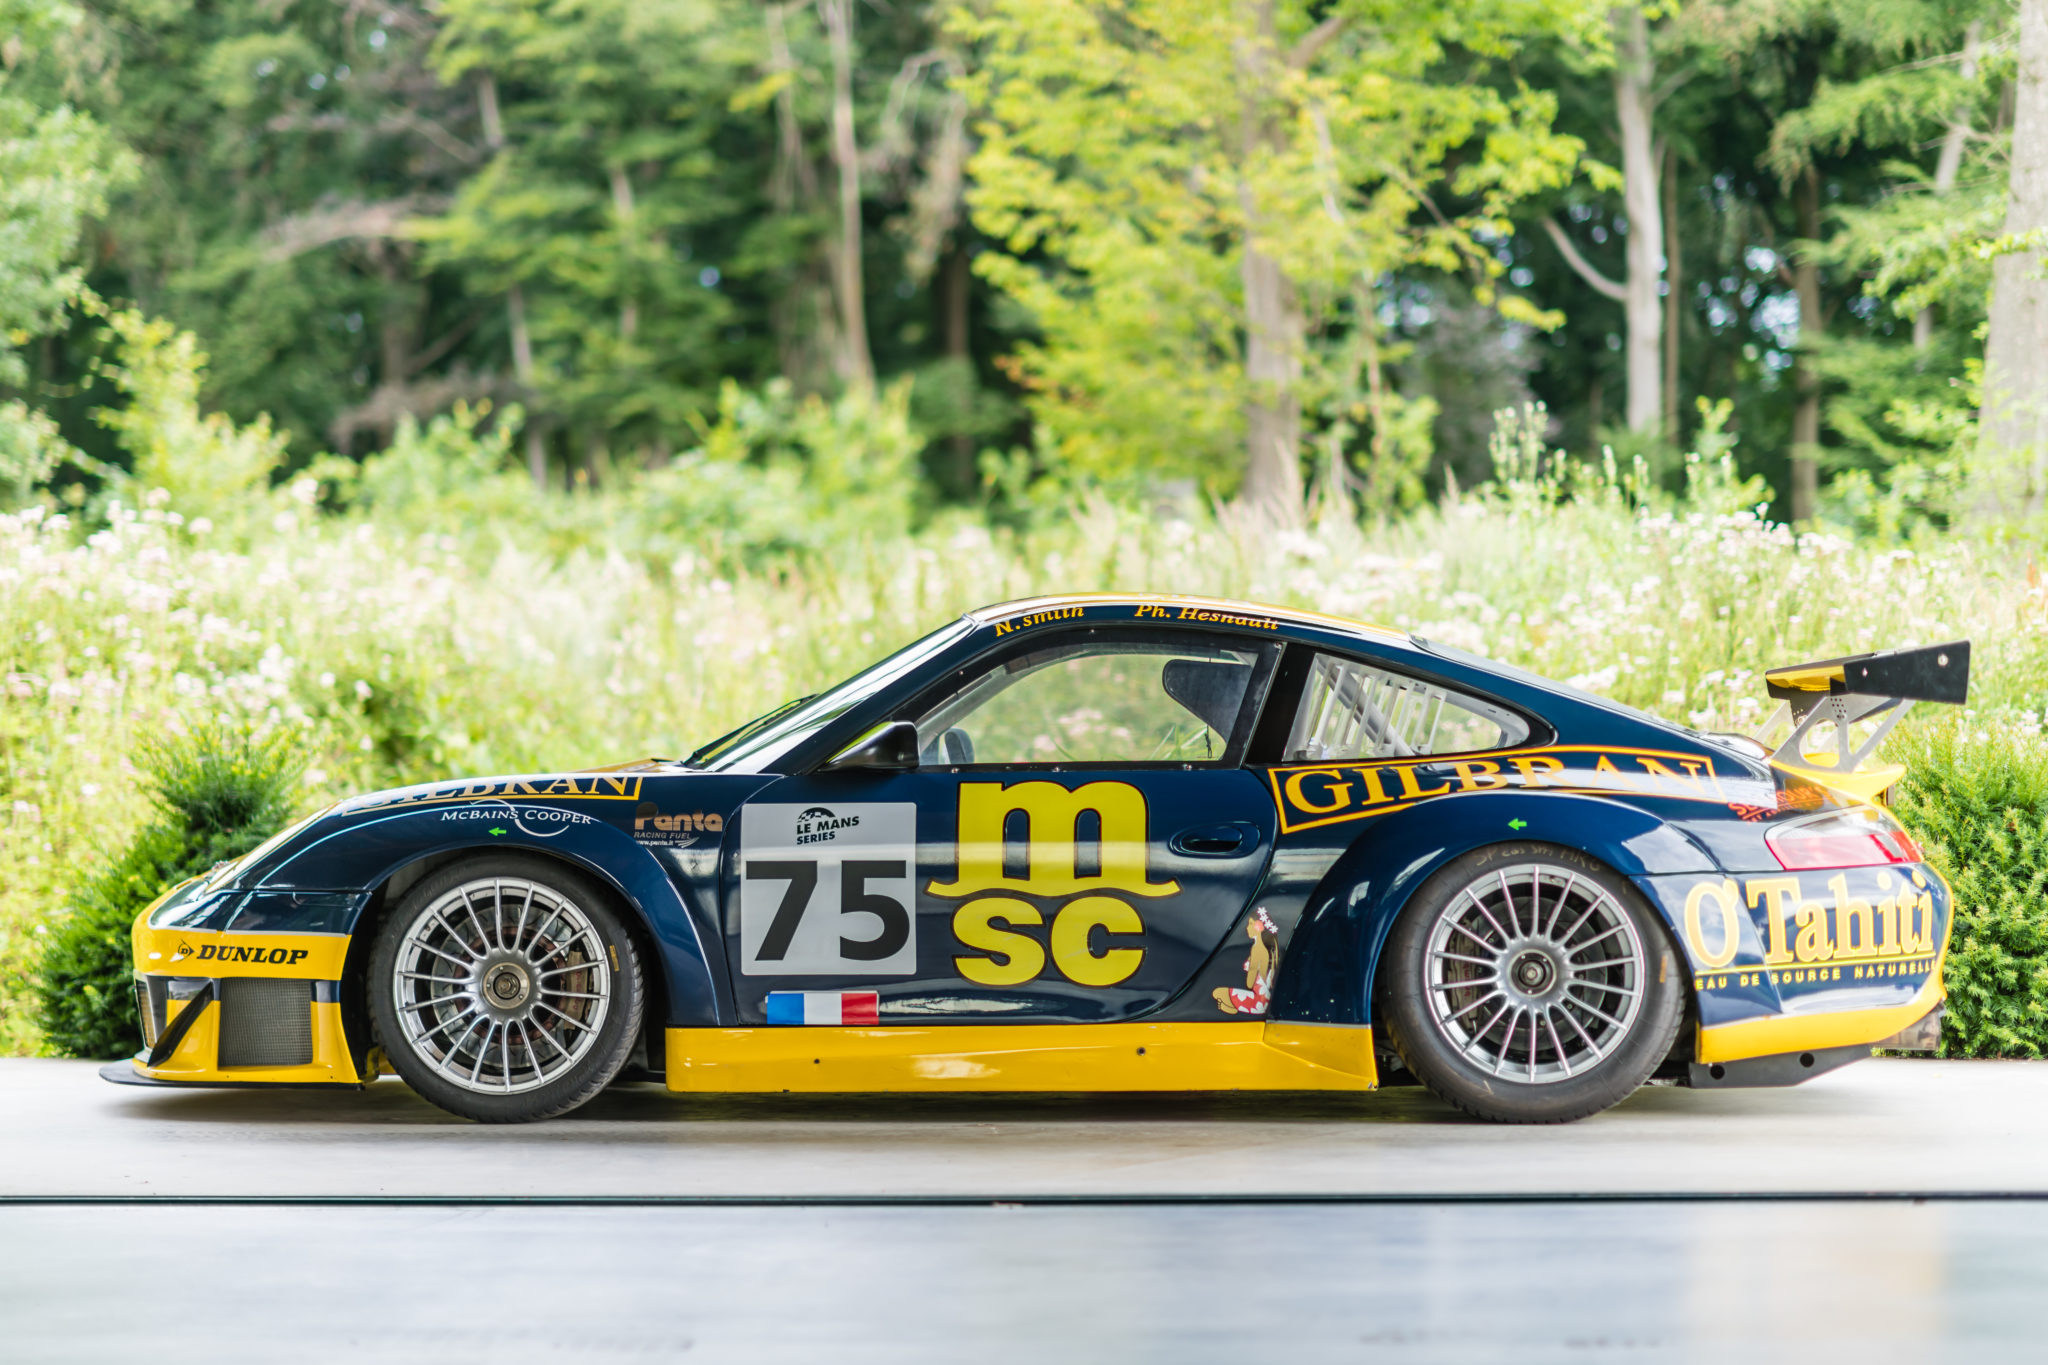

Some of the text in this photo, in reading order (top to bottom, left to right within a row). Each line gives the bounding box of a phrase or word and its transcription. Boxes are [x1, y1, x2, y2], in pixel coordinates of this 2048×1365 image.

[1134, 604, 1170, 617] Ph.
[1284, 755, 1702, 814] GILBRAN
[524, 810, 591, 824] COOPER
[635, 802, 723, 832] Panta
[797, 816, 860, 834] LE MANS
[797, 831, 836, 845] SERIES
[746, 860, 910, 961] 75
[1684, 871, 1935, 969] O'Tahiti
[196, 944, 308, 964] DUNLOP
[1695, 977, 1728, 991] EAU
[1740, 974, 1760, 987] DE
[1770, 967, 1841, 984] SOURCE
